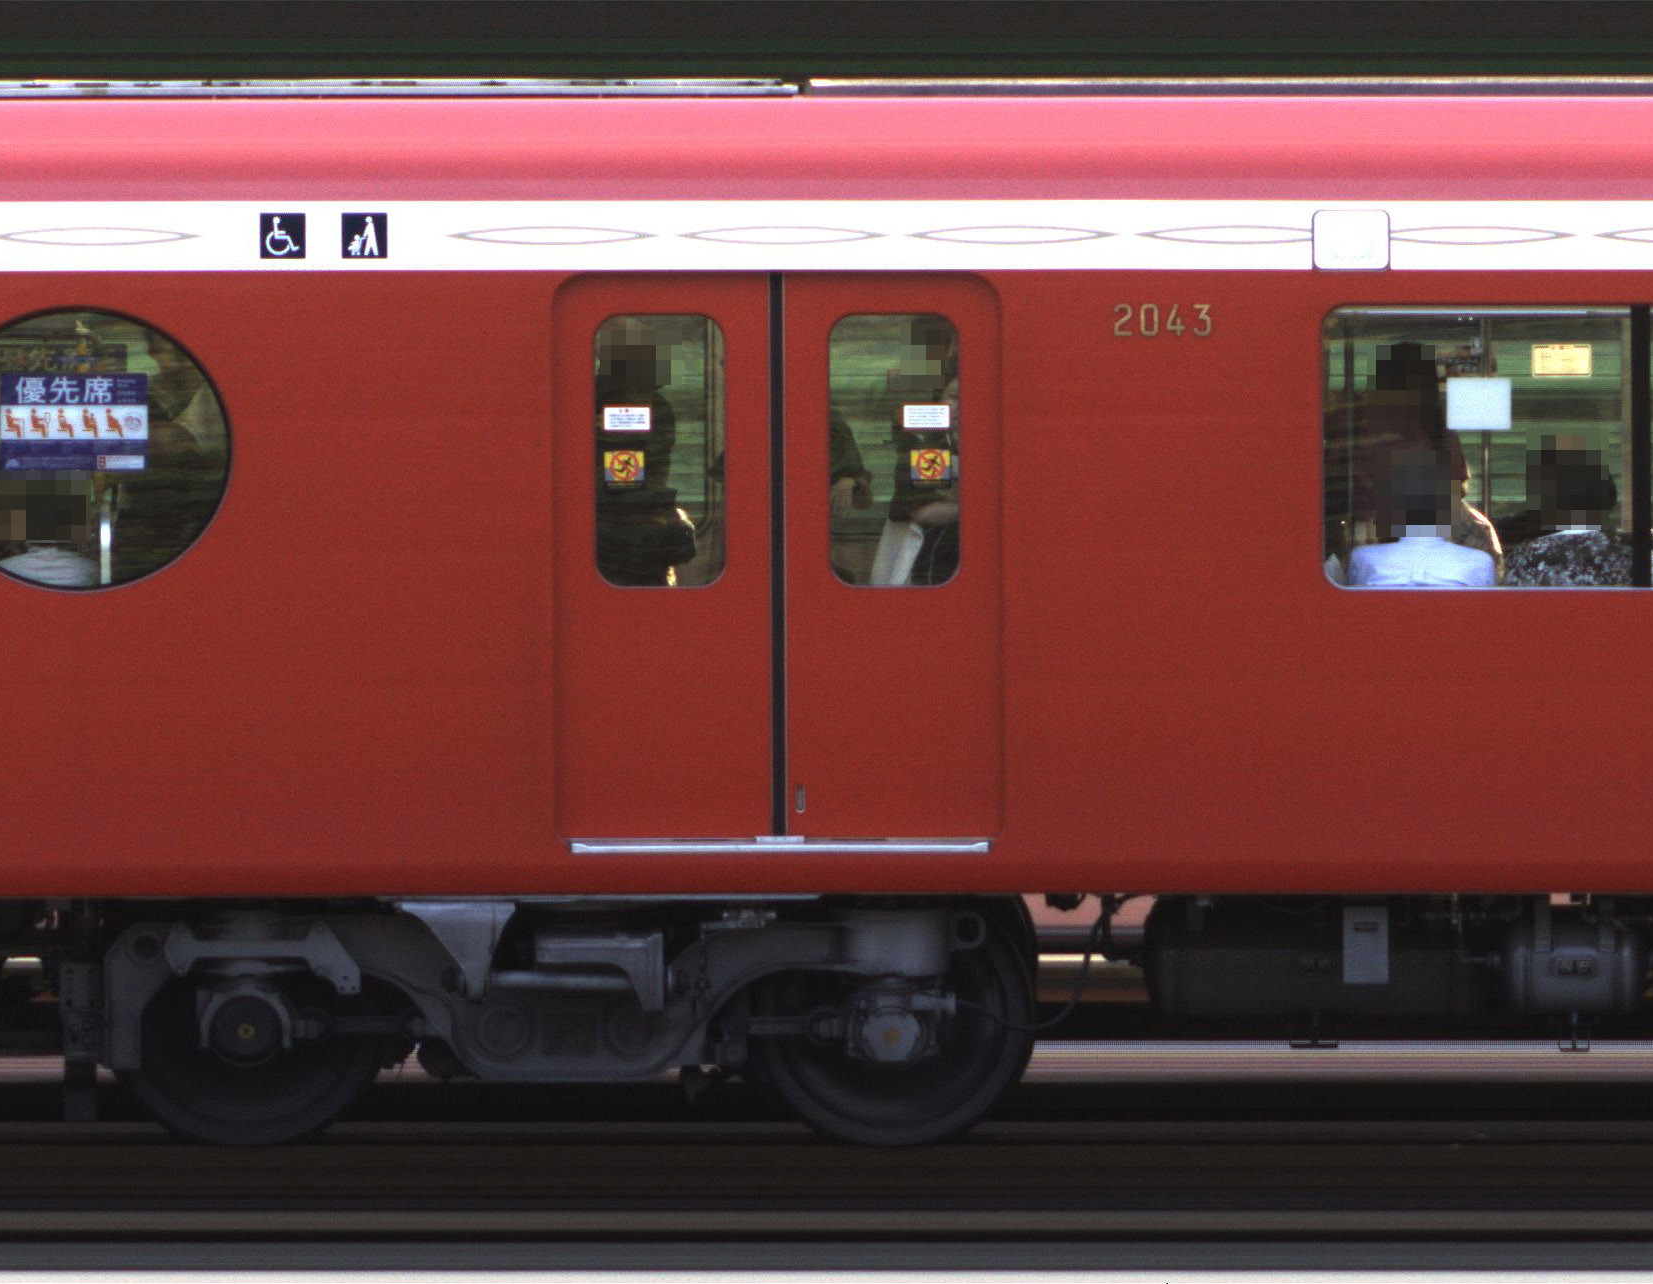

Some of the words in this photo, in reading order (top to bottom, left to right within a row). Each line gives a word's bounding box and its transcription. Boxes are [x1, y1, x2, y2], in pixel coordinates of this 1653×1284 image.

[1113, 303, 1212, 336] 2043
[15, 376, 114, 404] 優先席
